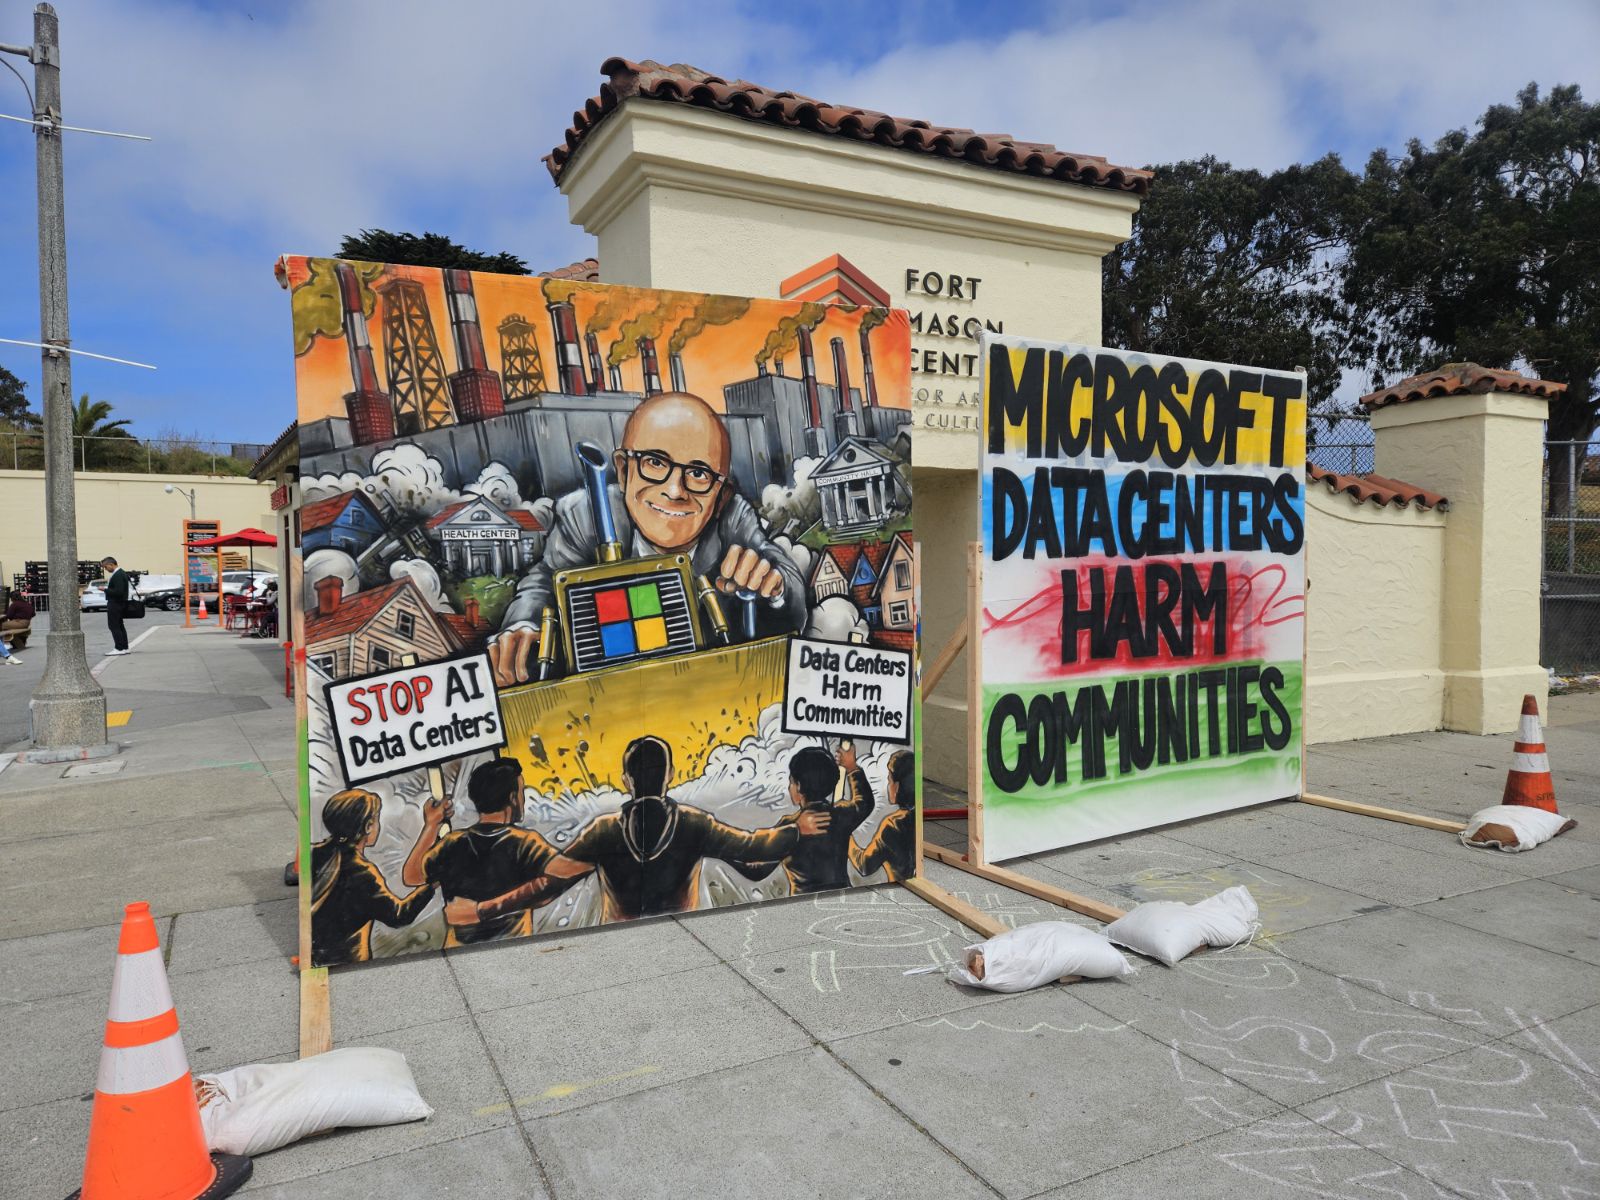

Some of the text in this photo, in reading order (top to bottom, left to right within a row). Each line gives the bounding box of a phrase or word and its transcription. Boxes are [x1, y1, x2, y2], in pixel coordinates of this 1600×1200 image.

[905, 268, 982, 300] FORT
[909, 310, 1003, 340] MASON
[912, 387, 980, 406] OR AR
[988, 343, 1303, 470] MICROSOFT
[817, 469, 879, 485] COMMUNITY HALL
[443, 529, 517, 539] HEALTH CENTER
[1060, 561, 1228, 665] HARM
[799, 645, 907, 678] Data Centers
[347, 661, 485, 726] STOP AI
[821, 673, 882, 702] Harm
[793, 696, 903, 729] Communities
[986, 664, 1292, 794] COMMUNITIES
[348, 711, 498, 768] Data Centers
